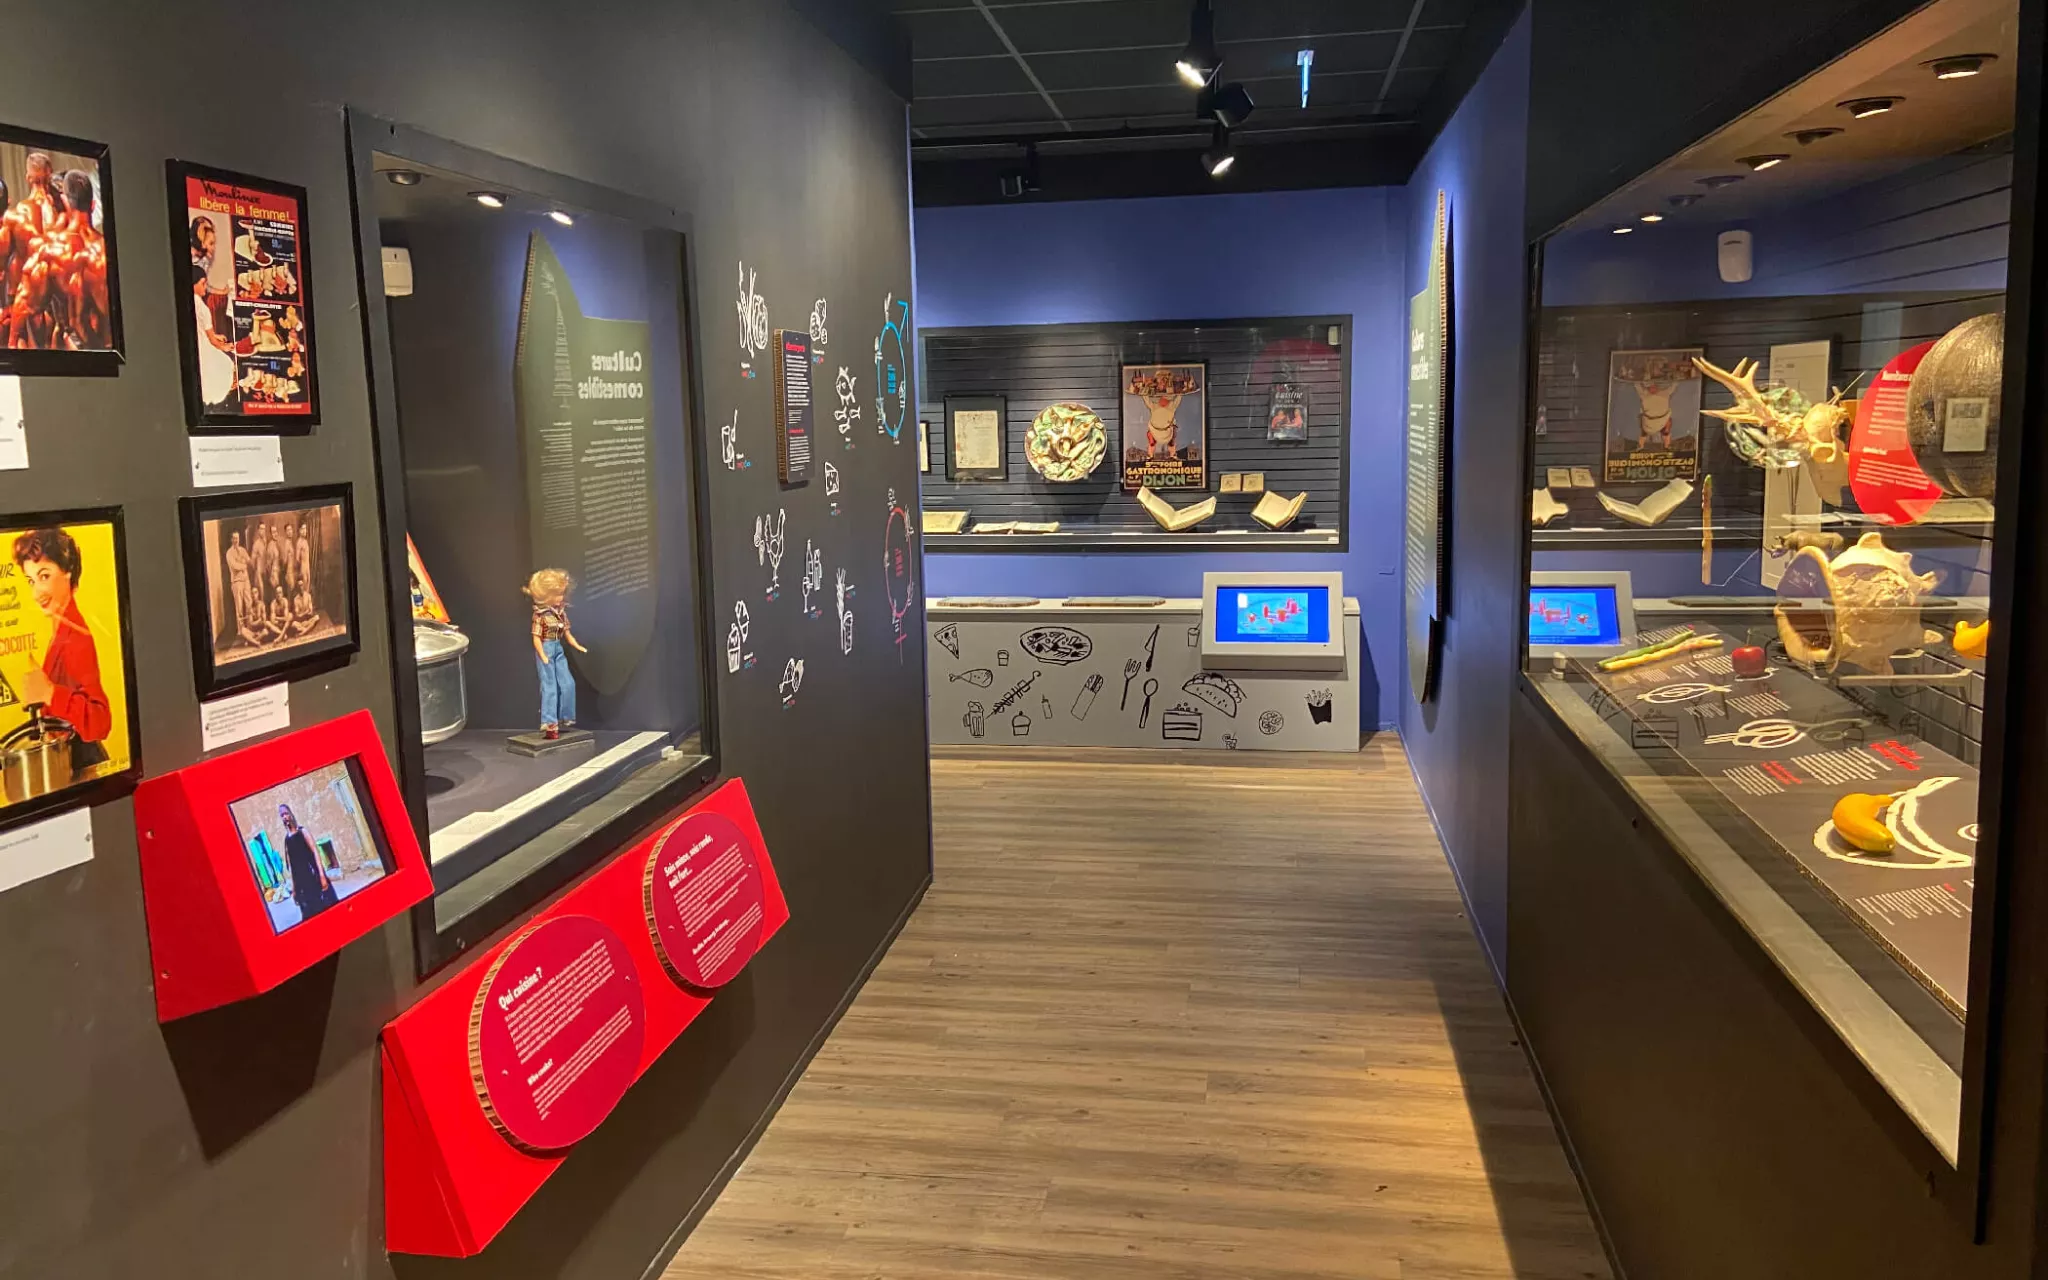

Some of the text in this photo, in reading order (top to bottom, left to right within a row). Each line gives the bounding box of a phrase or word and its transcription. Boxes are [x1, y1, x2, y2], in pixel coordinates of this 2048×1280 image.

[201, 179, 260, 203] Moulinex
[200, 196, 230, 212] libère
[235, 202, 245, 215] la
[1126, 467, 1202, 475] GASTRONOMIQUE
[1142, 474, 1186, 486] DIJON
[498, 988, 515, 1011] Qui
[513, 973, 539, 998] cuisine
